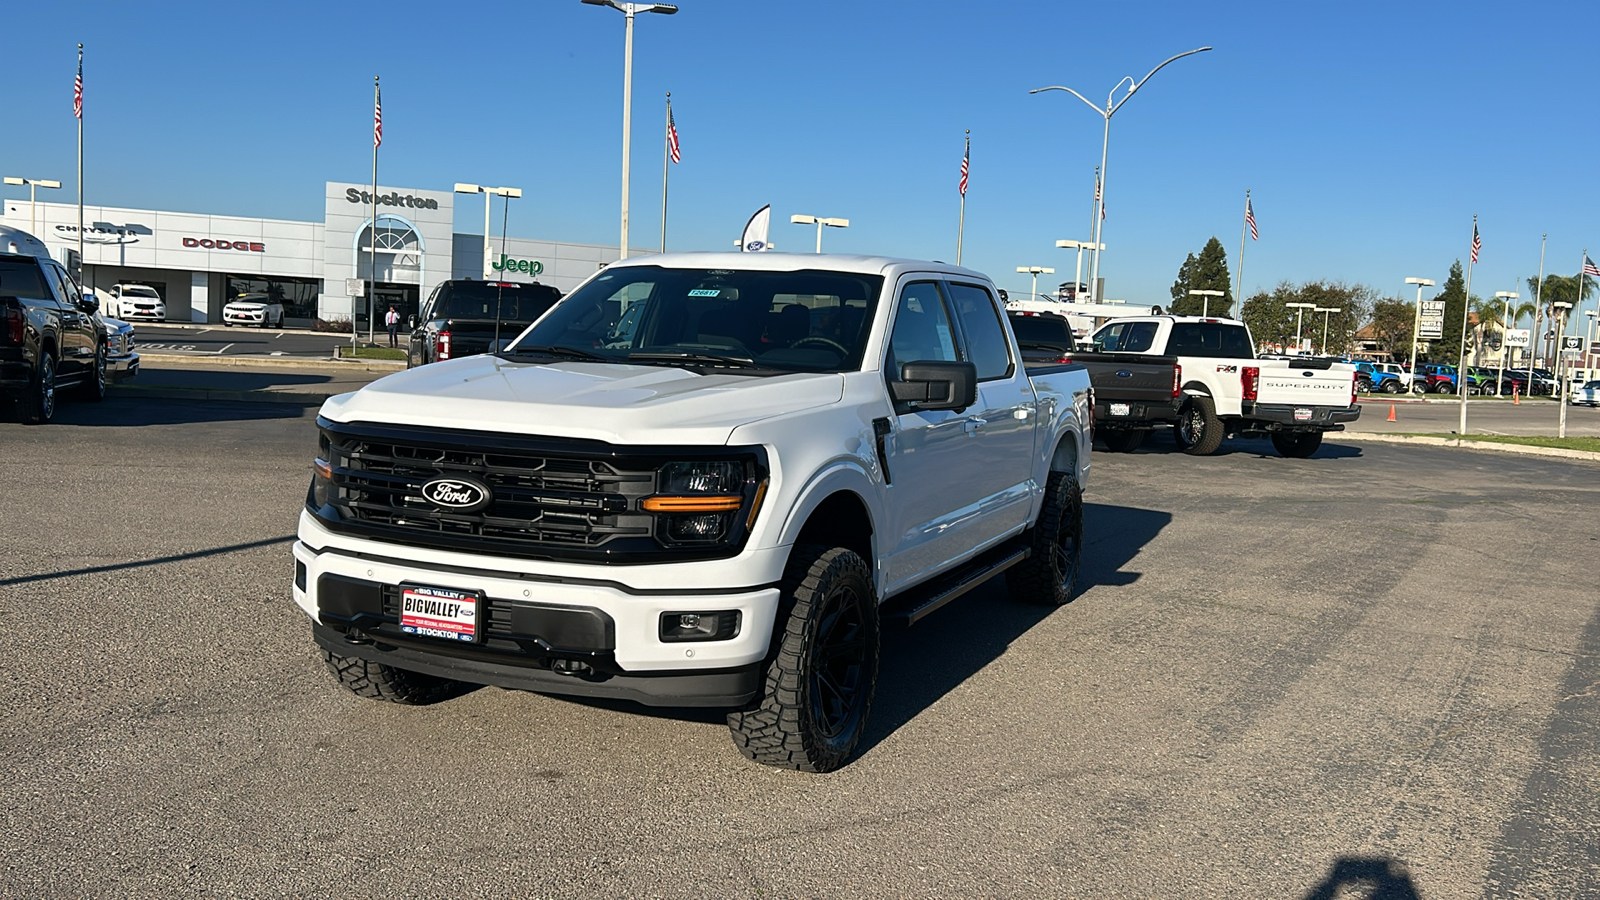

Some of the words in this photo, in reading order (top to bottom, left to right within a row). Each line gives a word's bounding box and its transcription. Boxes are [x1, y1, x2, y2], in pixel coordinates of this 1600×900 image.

[346, 188, 438, 210] Stockton
[182, 237, 266, 252] DODGE
[492, 253, 543, 277] Jeep
[1422, 302, 1443, 310] OEM
[1507, 335, 1529, 344] Jeep
[1216, 364, 1238, 373] FX4
[433, 482, 472, 503] Ford
[433, 590, 459, 599] VALLEY
[404, 597, 461, 618] BIGVALLEY
[416, 627, 459, 639] STOCKTON
